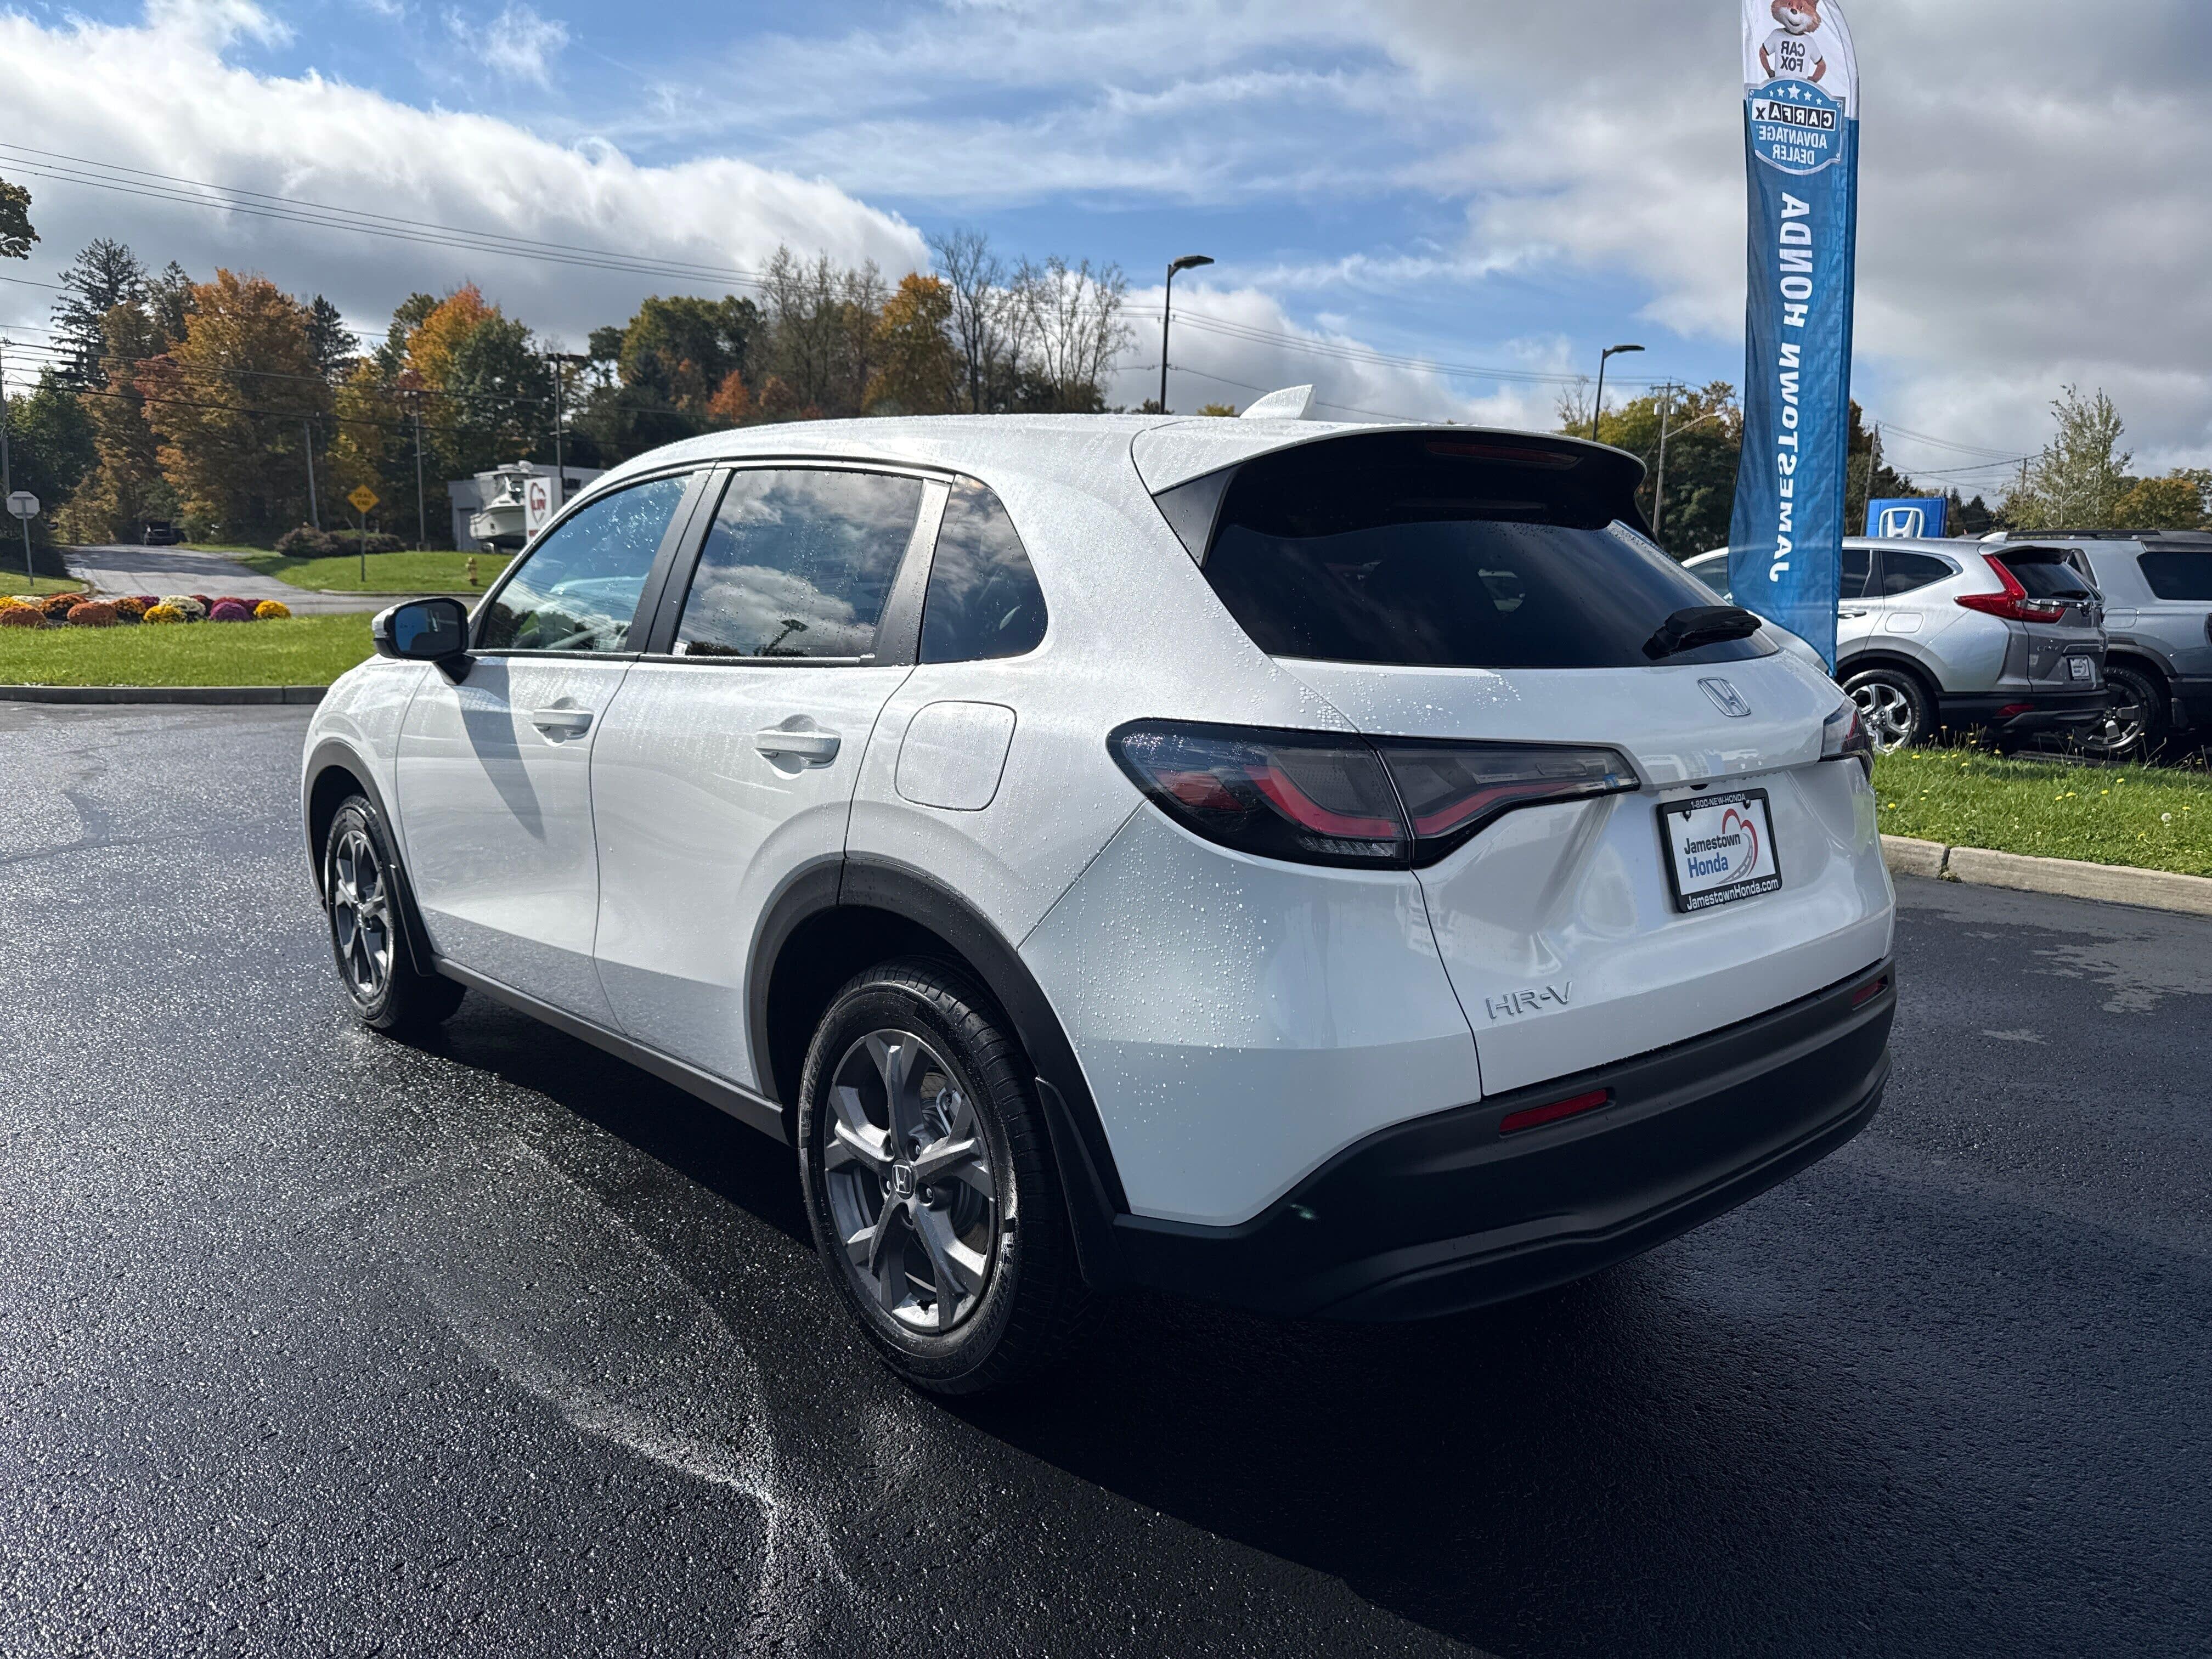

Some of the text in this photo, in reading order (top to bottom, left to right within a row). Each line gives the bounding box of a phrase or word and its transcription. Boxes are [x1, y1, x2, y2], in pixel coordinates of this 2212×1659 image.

[1690, 793, 1746, 809] 1-800-NEW-HONDA
[1684, 833, 1741, 855] Jamestown
[1687, 852, 1729, 878] Honda
[1686, 878, 1779, 910] JamestownHonda.com
[1485, 981, 1572, 1019] HR-V
